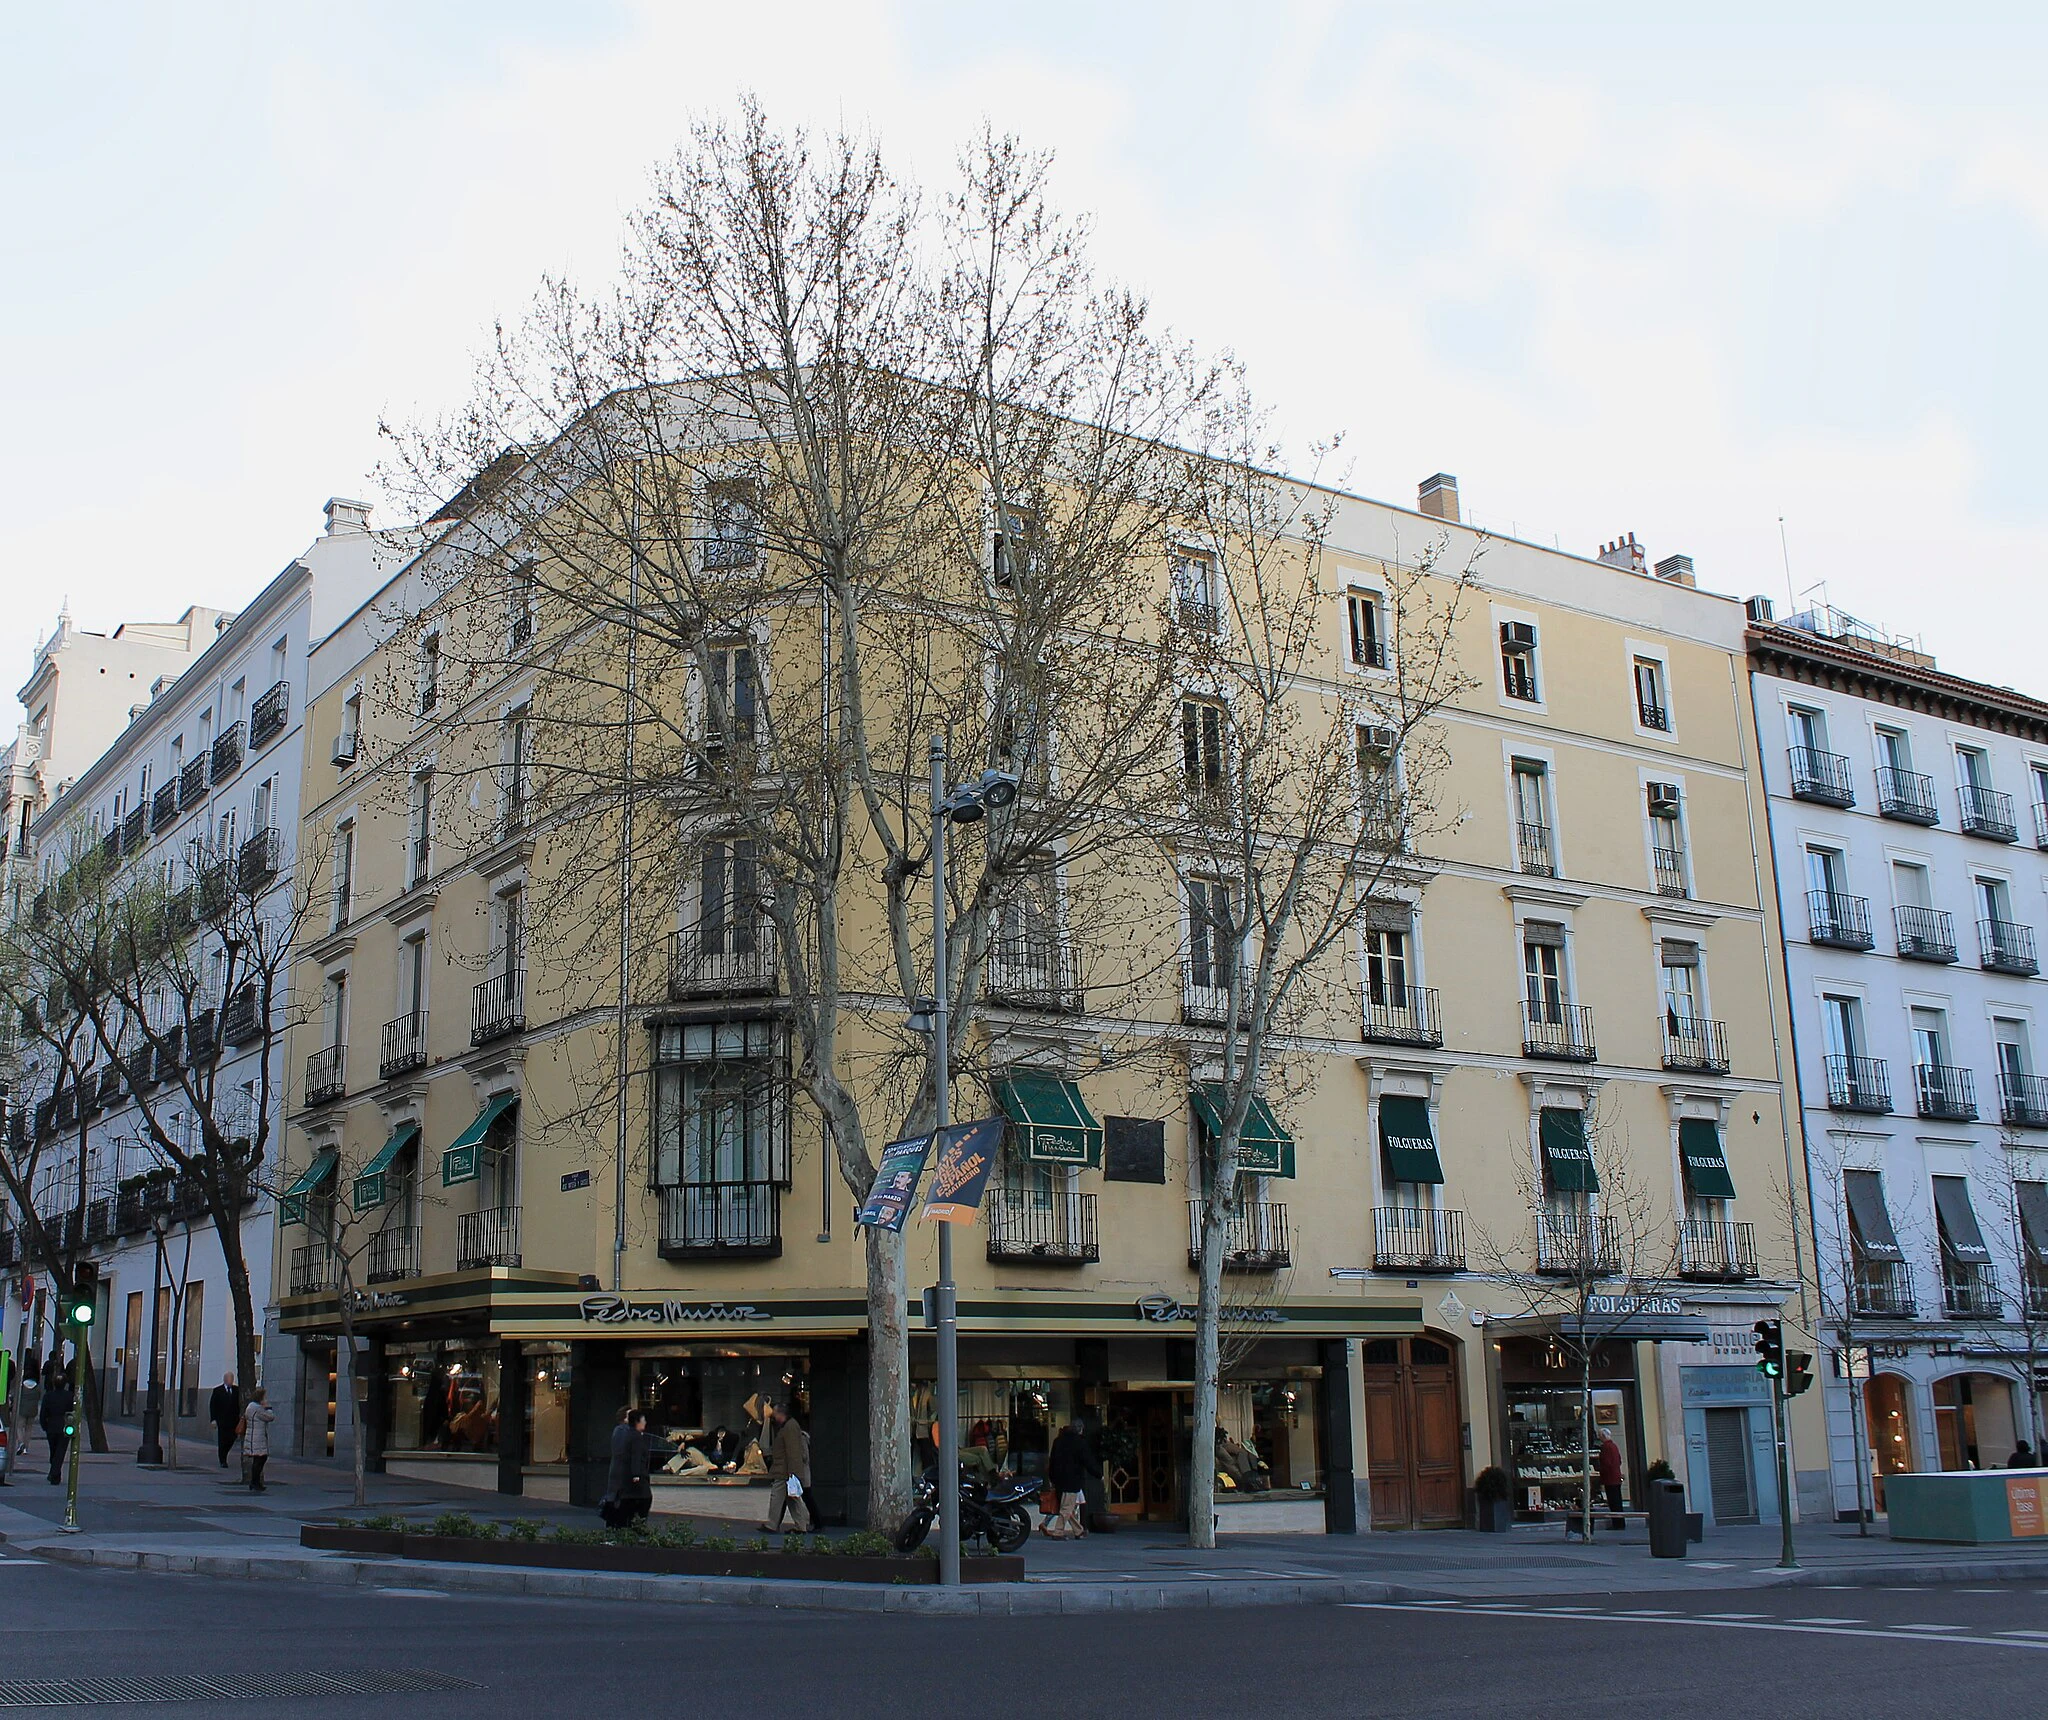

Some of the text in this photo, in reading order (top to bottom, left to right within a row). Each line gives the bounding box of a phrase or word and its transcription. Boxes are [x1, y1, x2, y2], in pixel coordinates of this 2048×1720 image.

[1037, 1134, 1073, 1146] Pedro
[1387, 1135, 1433, 1150] FOLGUERAS
[1547, 1146, 1589, 1160] FOLGUERAS
[1687, 1155, 1725, 1168] FOLGUERAS
[936, 1152, 986, 1198] ESPAÑOL
[944, 1166, 981, 1198] MATADERO
[883, 1194, 902, 1202] MARZO
[580, 1293, 771, 1325] Pedro Muñoz
[1136, 1293, 1290, 1322] Pedr uñoz
